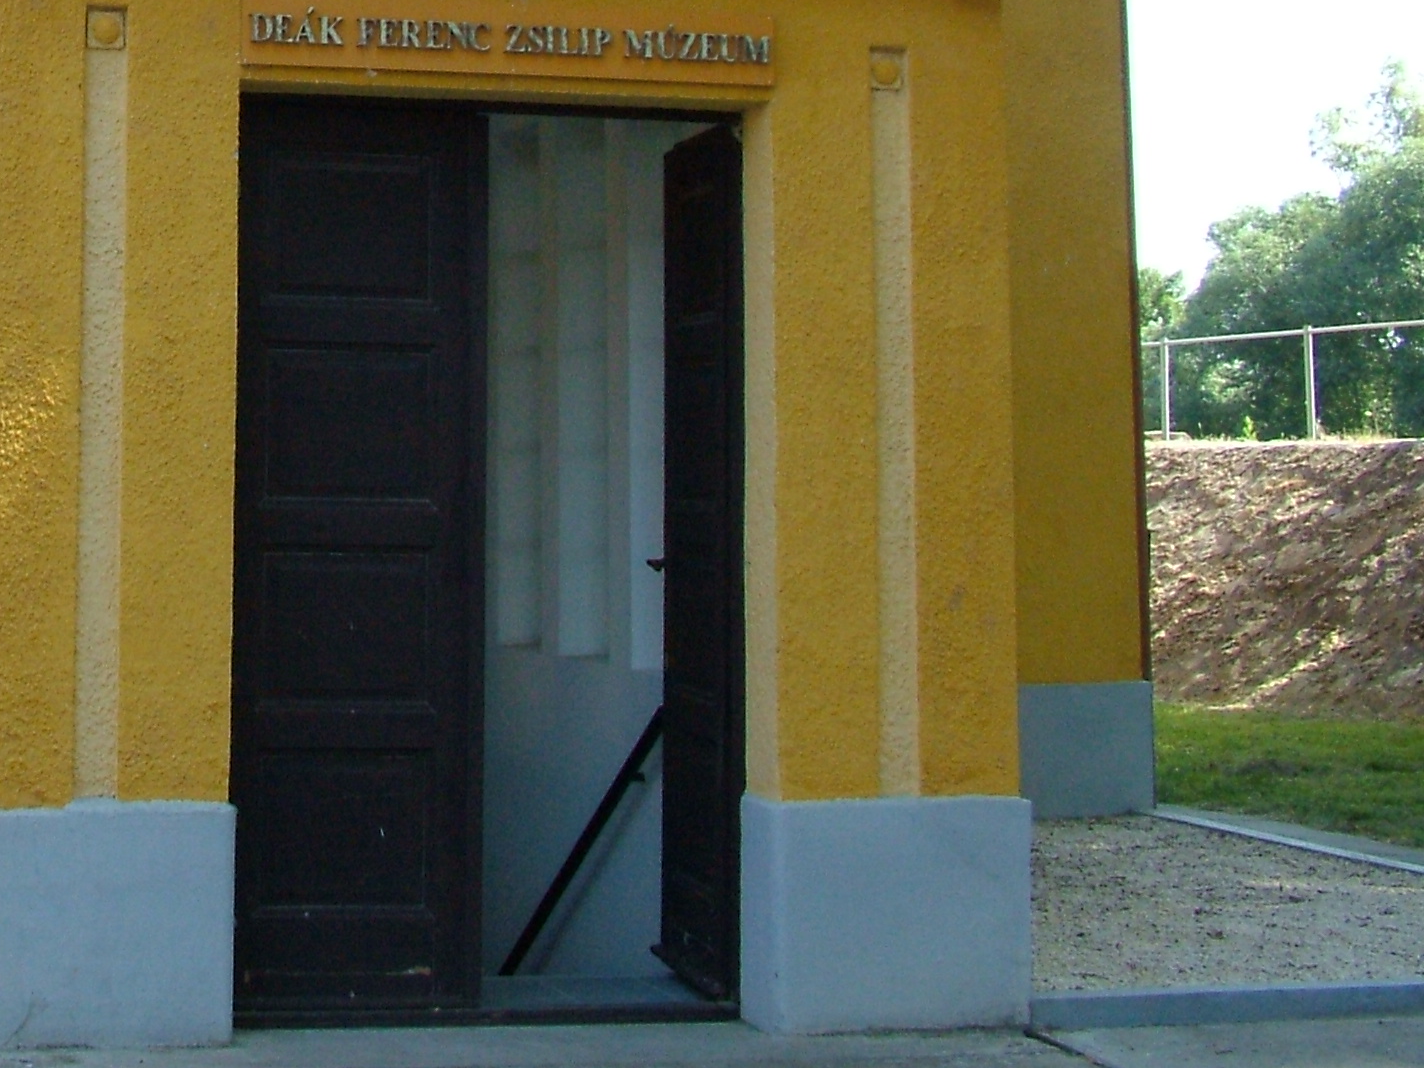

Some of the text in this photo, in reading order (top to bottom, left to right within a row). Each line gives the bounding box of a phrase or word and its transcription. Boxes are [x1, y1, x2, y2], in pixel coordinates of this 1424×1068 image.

[249, 7, 772, 64] DEÁK FERENC ZSILIP MÚZEUM
